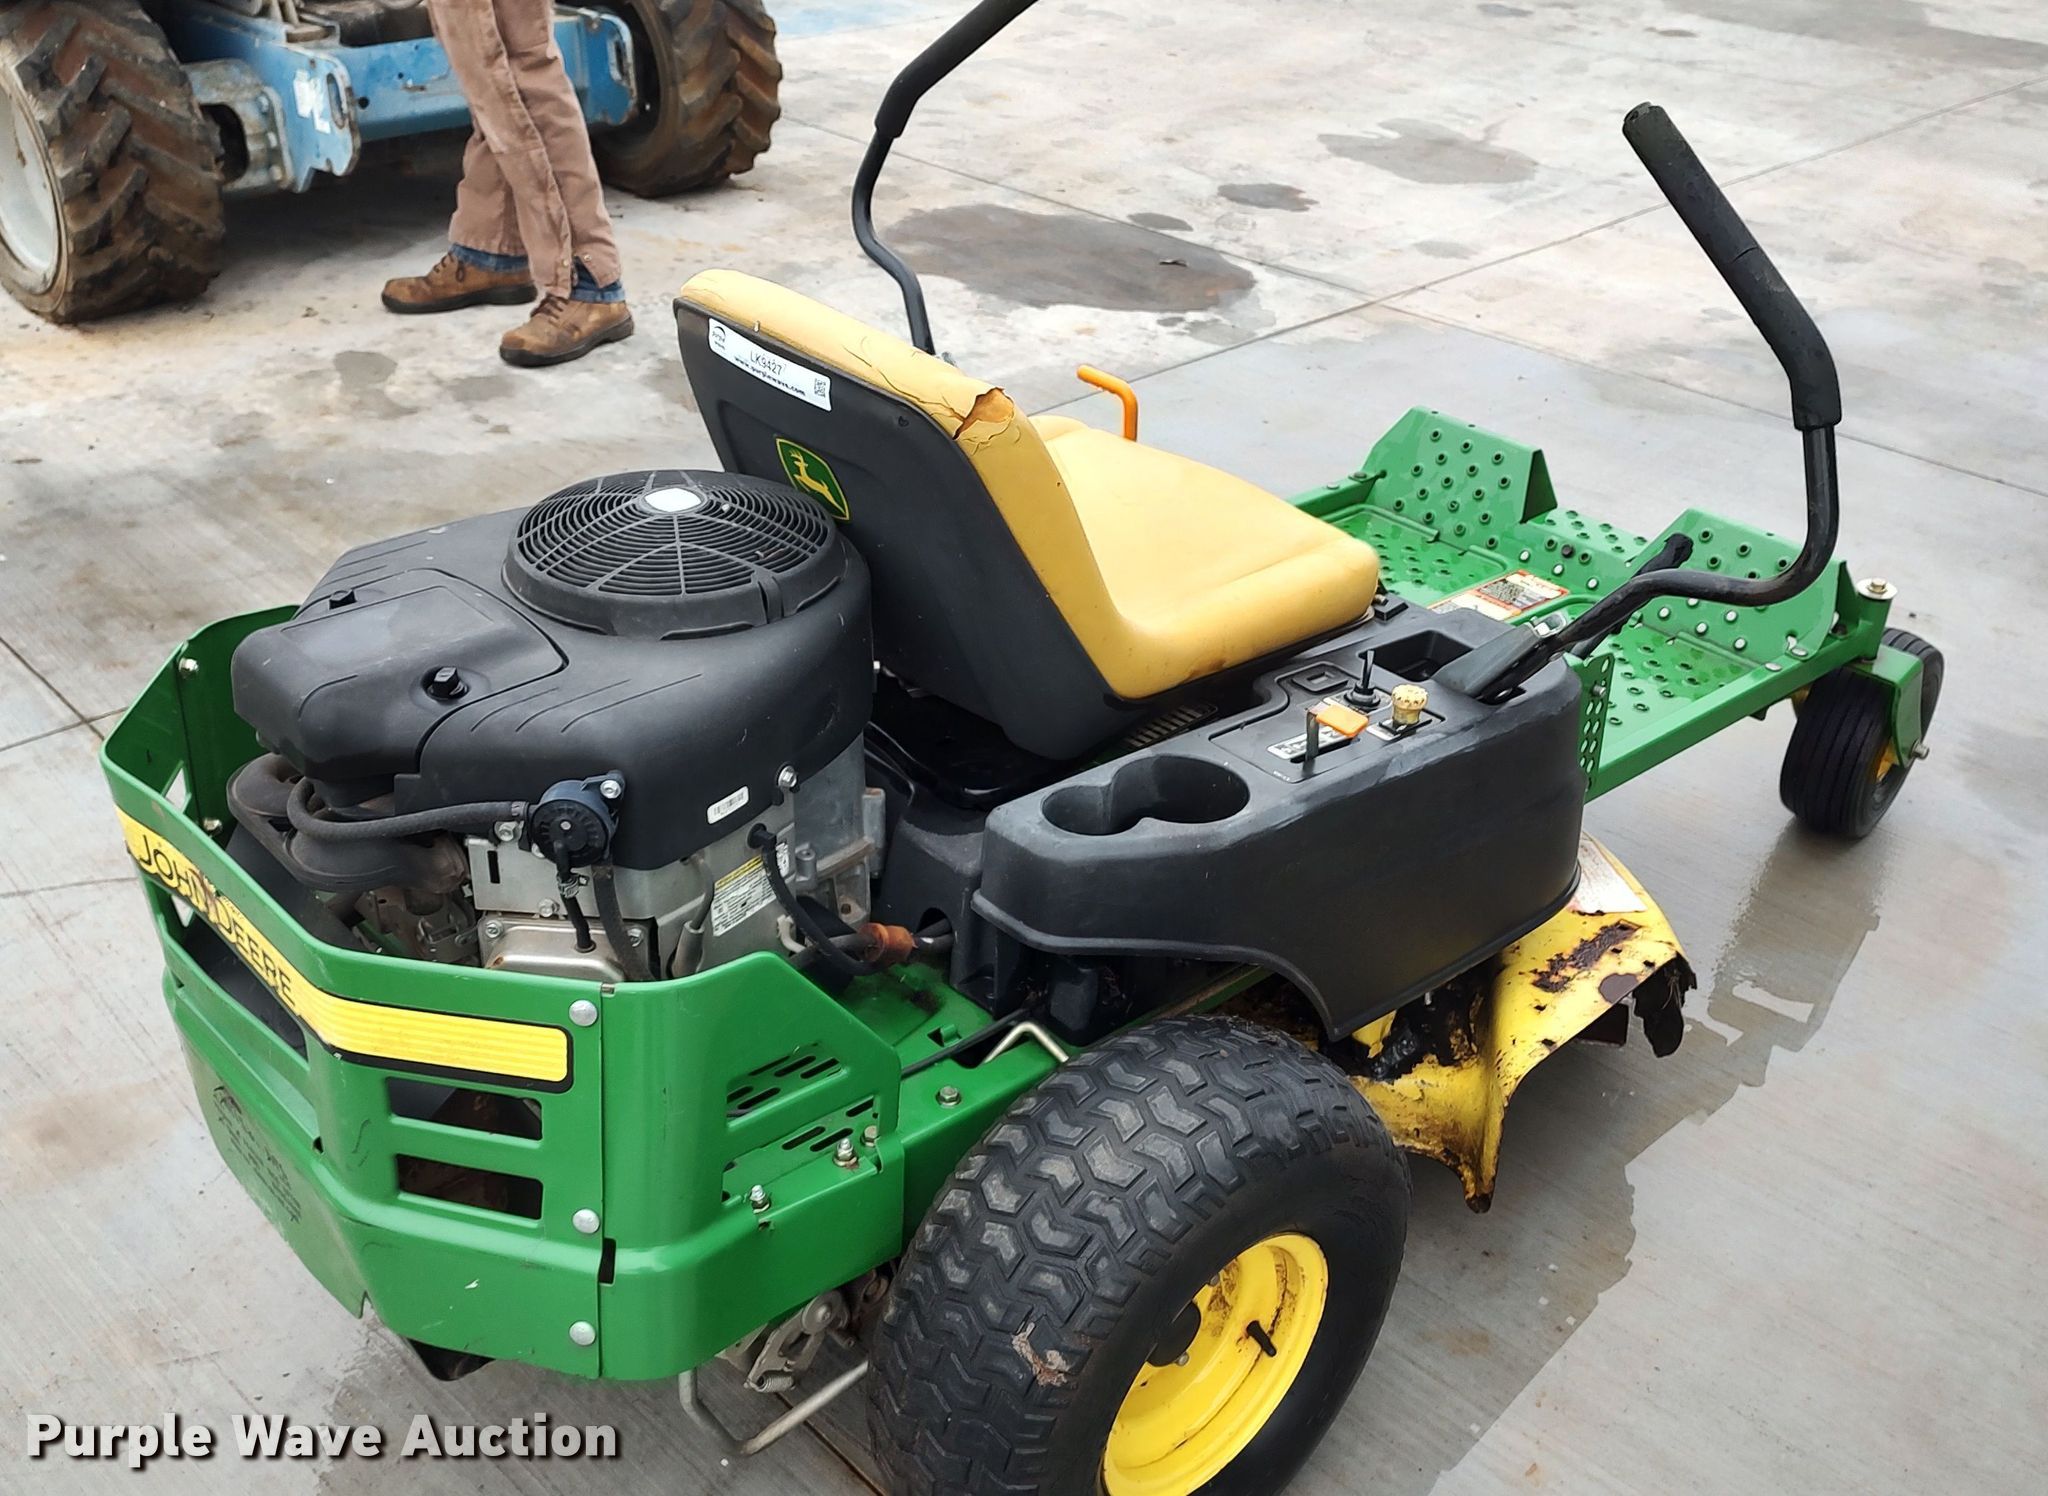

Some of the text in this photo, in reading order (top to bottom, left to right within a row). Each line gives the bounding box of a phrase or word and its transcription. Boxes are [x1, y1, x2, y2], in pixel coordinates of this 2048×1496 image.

[750, 350, 783, 375] LK9427
[139, 834, 213, 912] JOHN
[212, 898, 296, 1007] DEERE
